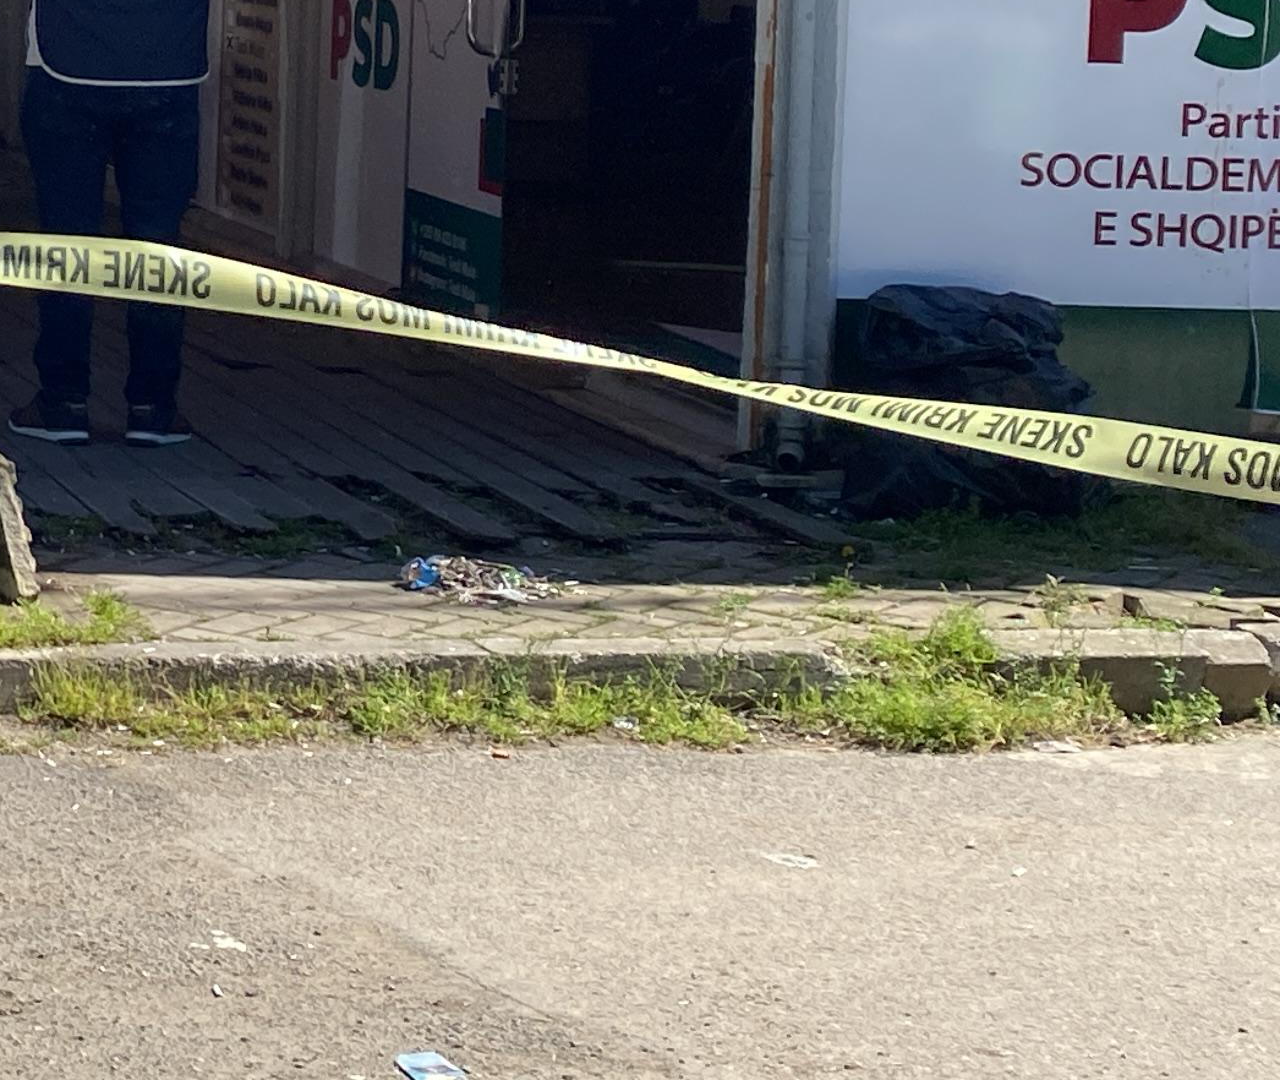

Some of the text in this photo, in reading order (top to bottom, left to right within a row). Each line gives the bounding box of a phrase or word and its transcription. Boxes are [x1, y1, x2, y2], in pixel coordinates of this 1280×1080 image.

[1019, 151, 1280, 193] SOCIALDEM
[1094, 210, 1119, 246] E
[870, 397, 978, 434] KRIMI
[978, 412, 1094, 458] SKENE
[1126, 431, 1218, 481] KALO
